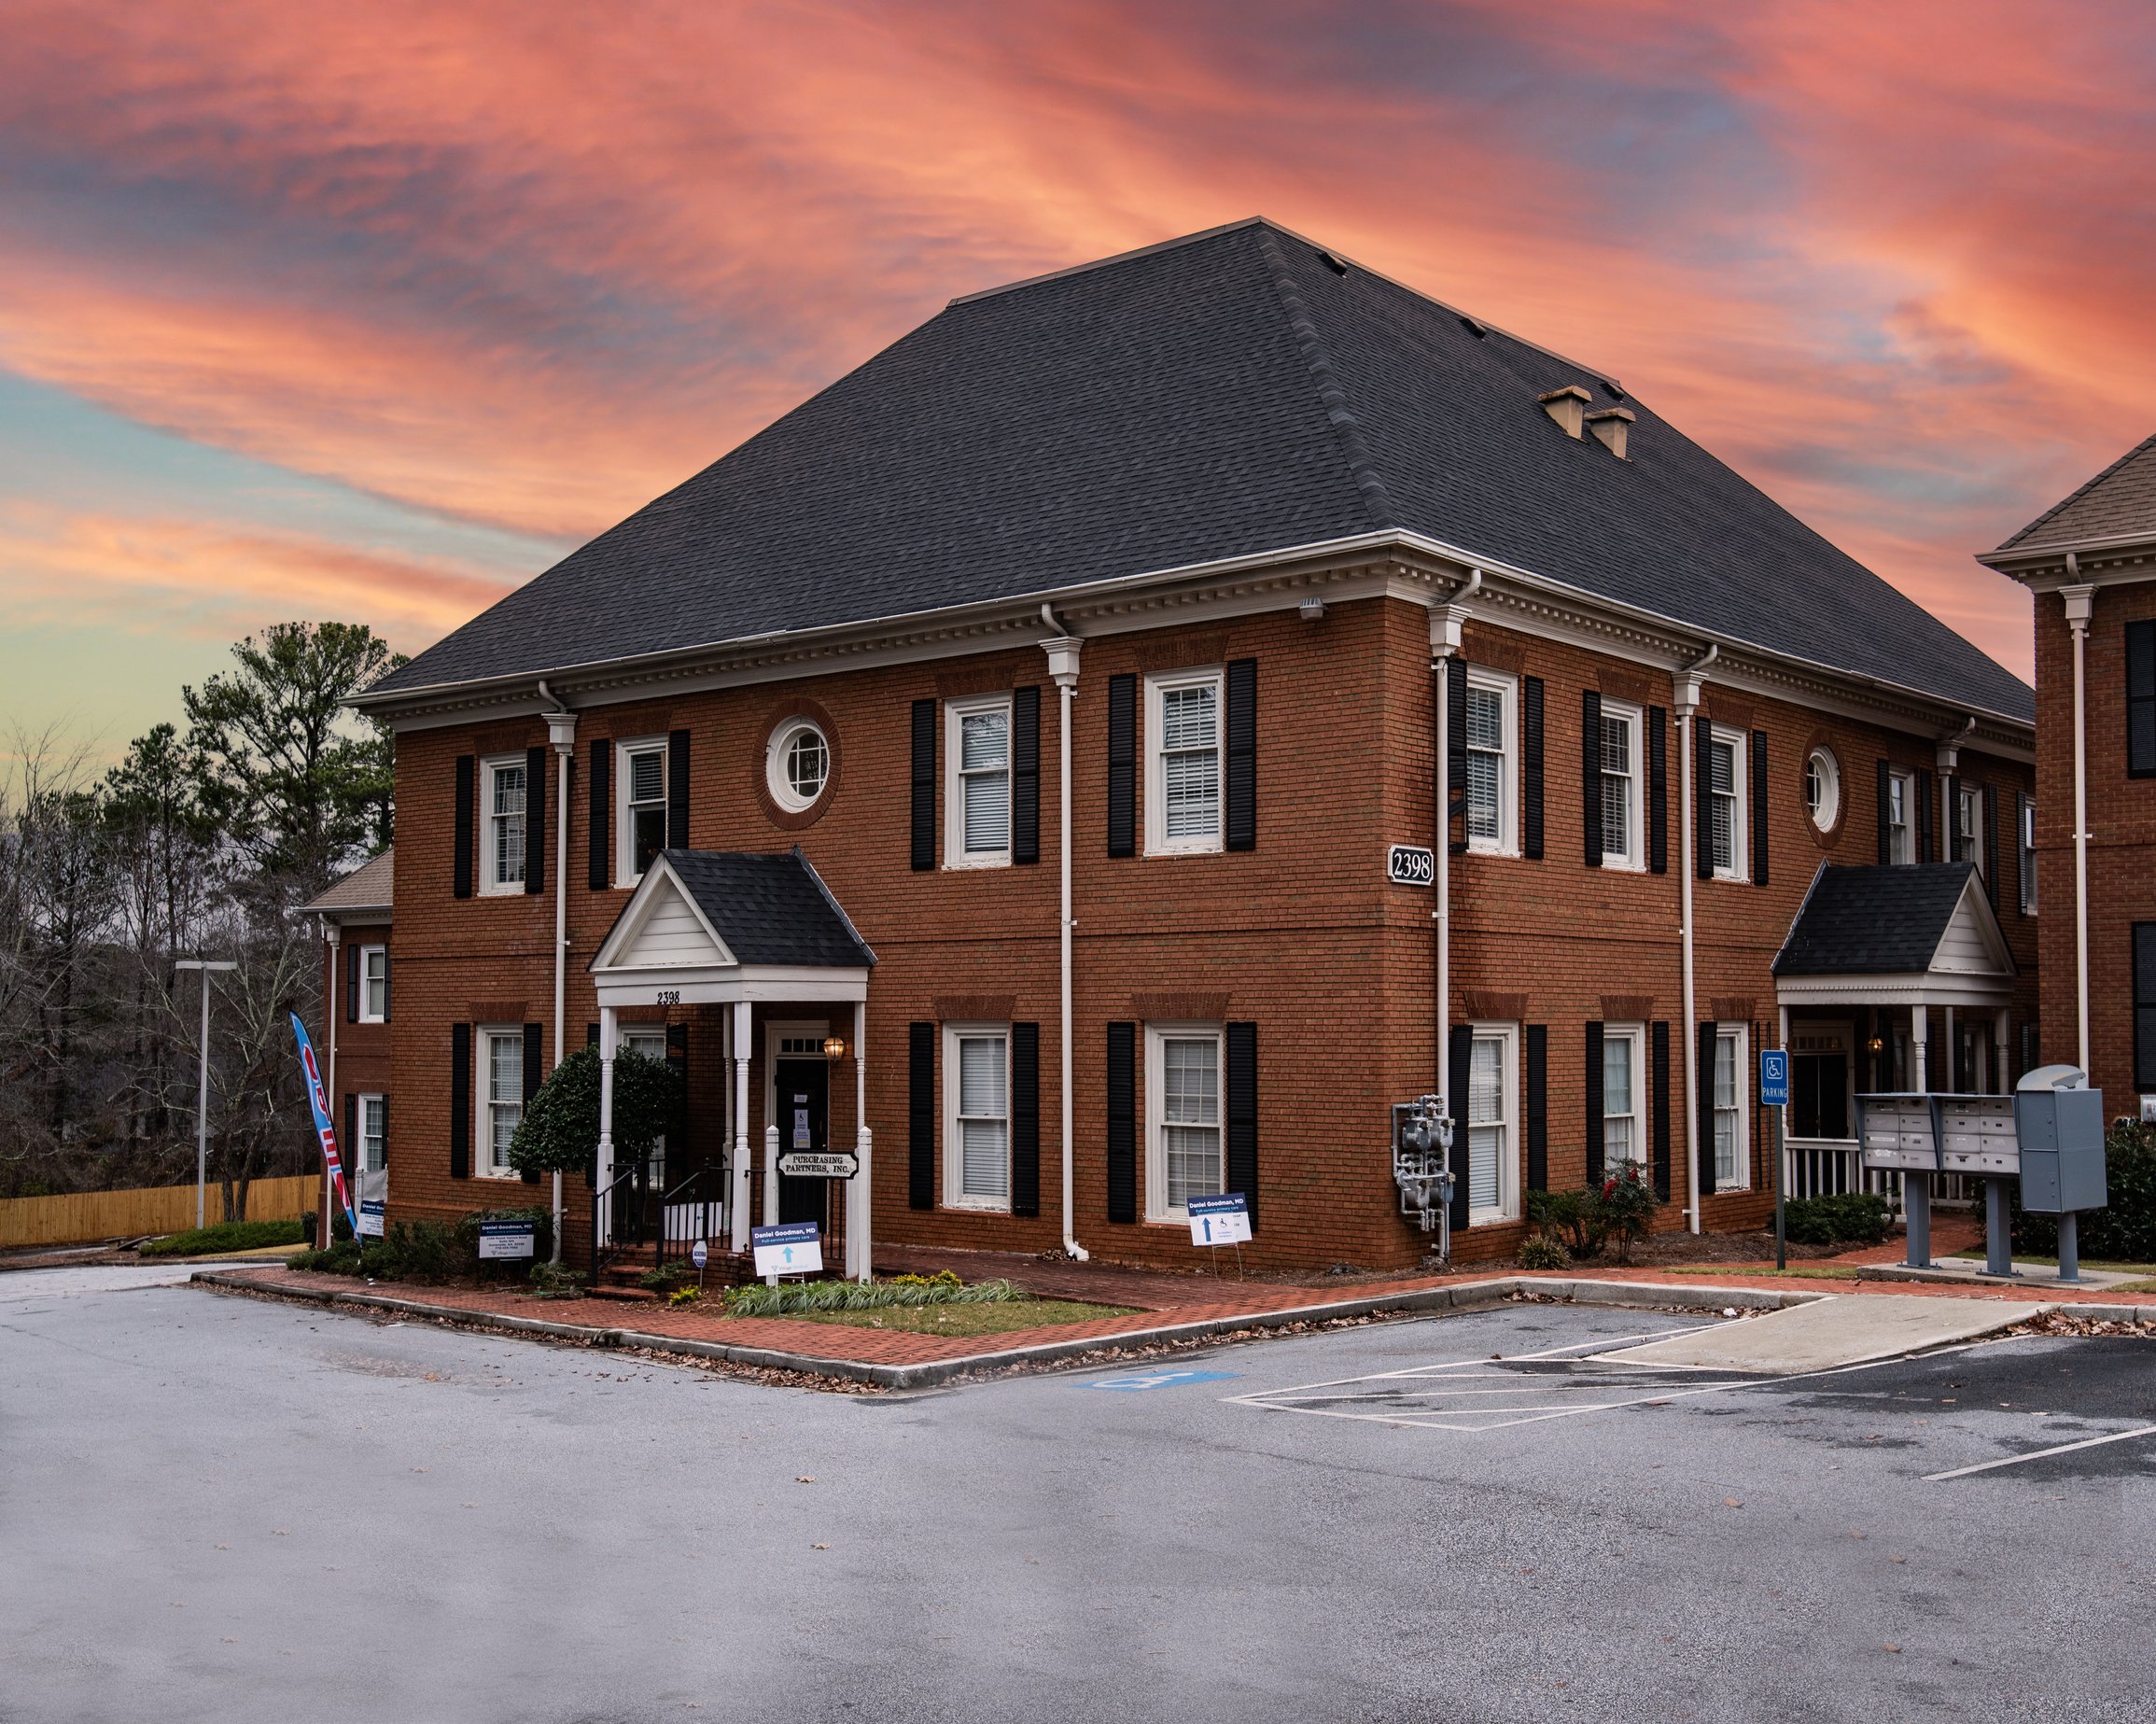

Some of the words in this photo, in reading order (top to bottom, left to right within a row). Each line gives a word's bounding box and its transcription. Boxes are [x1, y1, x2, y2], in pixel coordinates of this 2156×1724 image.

[1393, 852, 1431, 879] 2398
[657, 990, 680, 1005] 2398
[1762, 1086, 1787, 1099] PARKING
[786, 1164, 829, 1173] PARTNERS,
